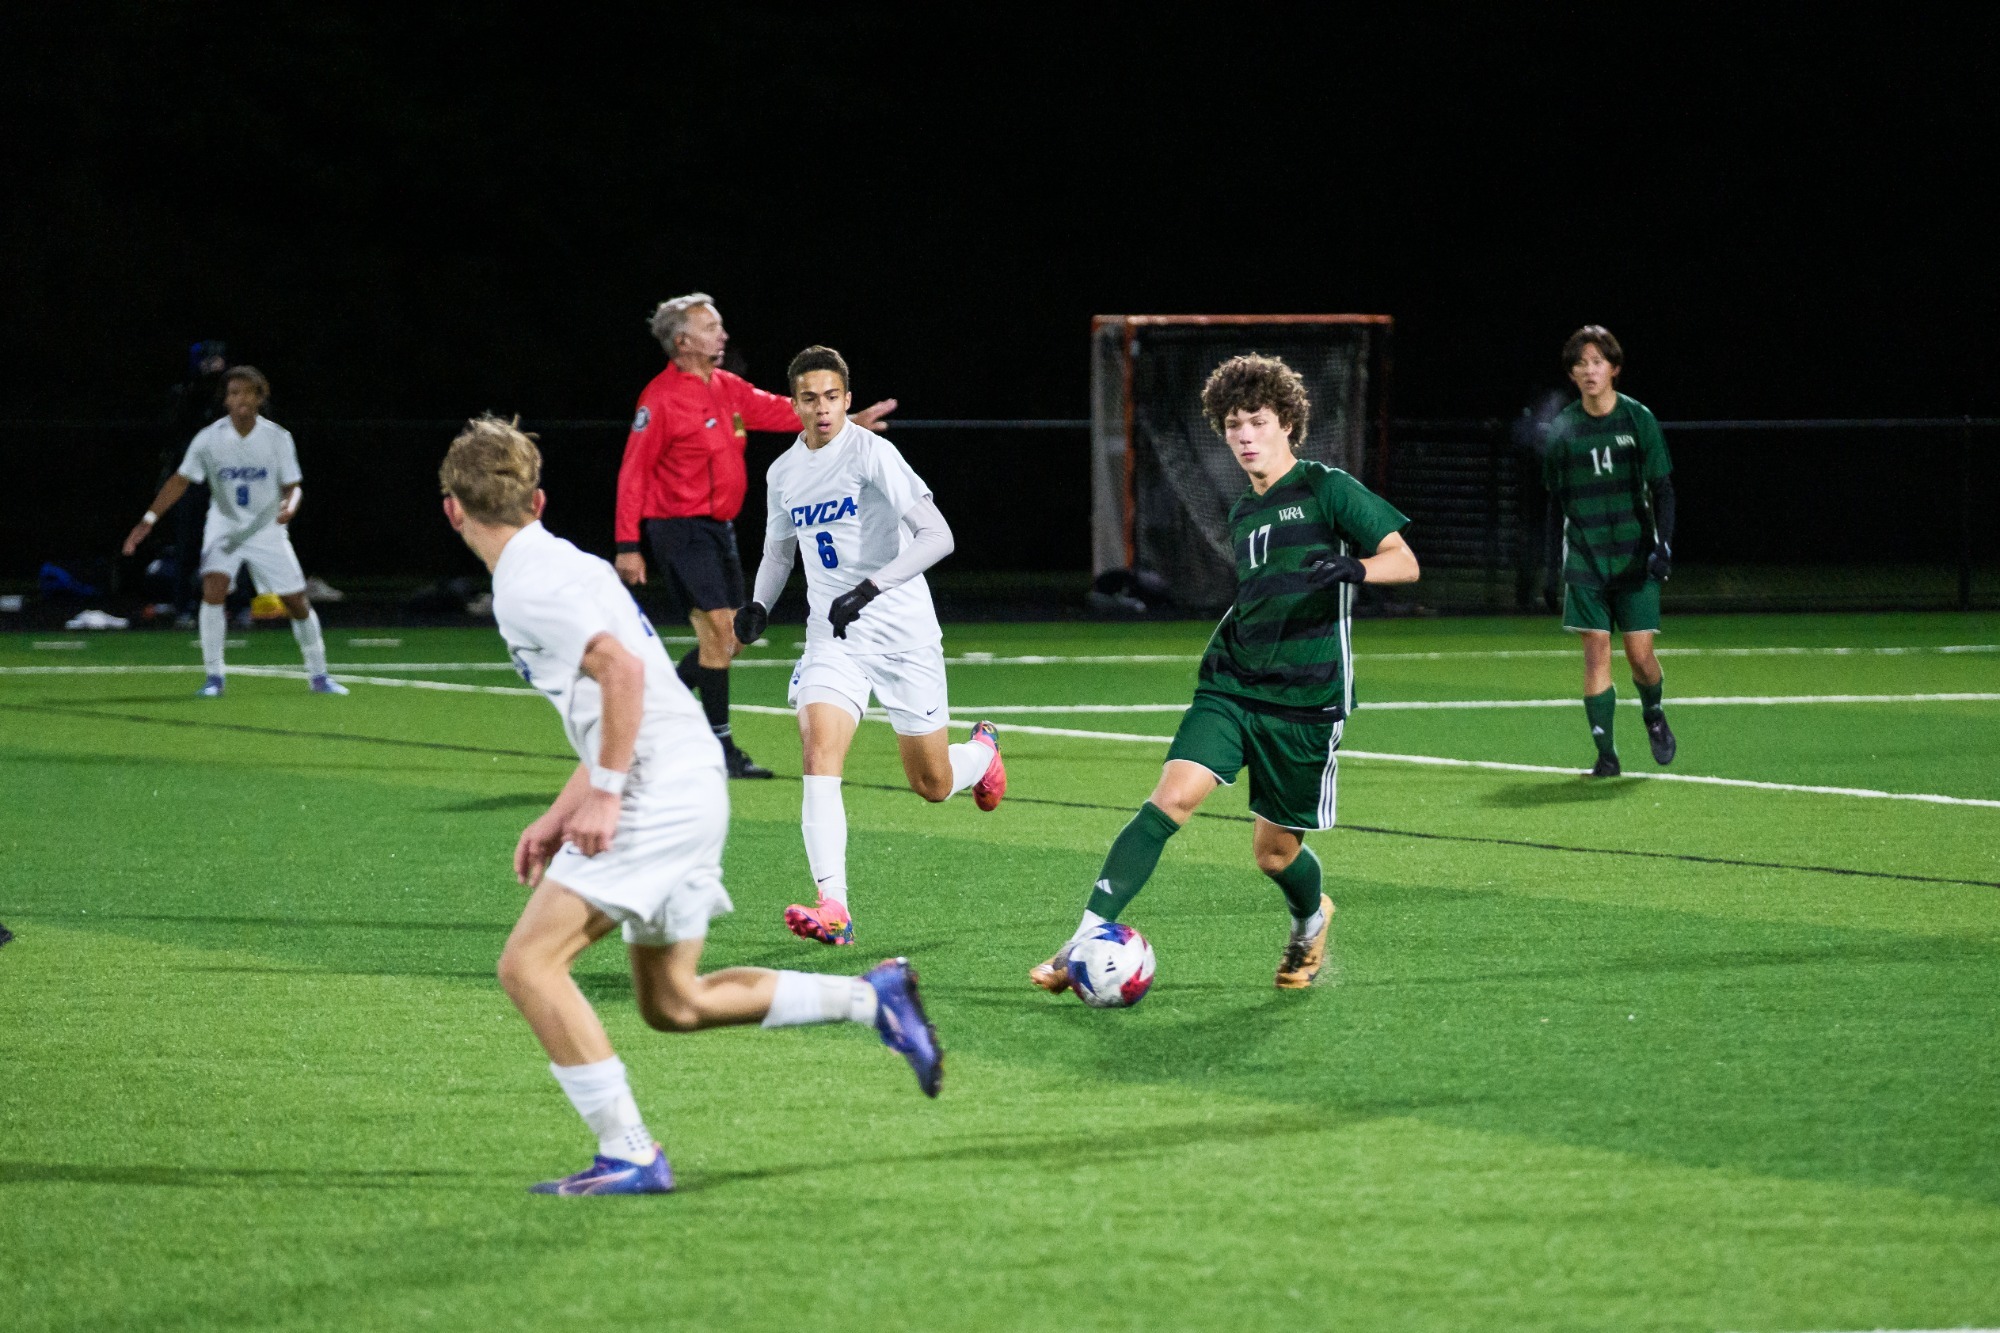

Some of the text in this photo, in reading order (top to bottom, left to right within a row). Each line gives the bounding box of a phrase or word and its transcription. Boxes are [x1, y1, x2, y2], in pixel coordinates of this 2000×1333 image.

[1590, 445, 1613, 476] 14
[791, 496, 858, 527] CVCA
[1279, 506, 1305, 521] WRA
[816, 531, 839, 569] 6
[1248, 523, 1272, 569] 17
